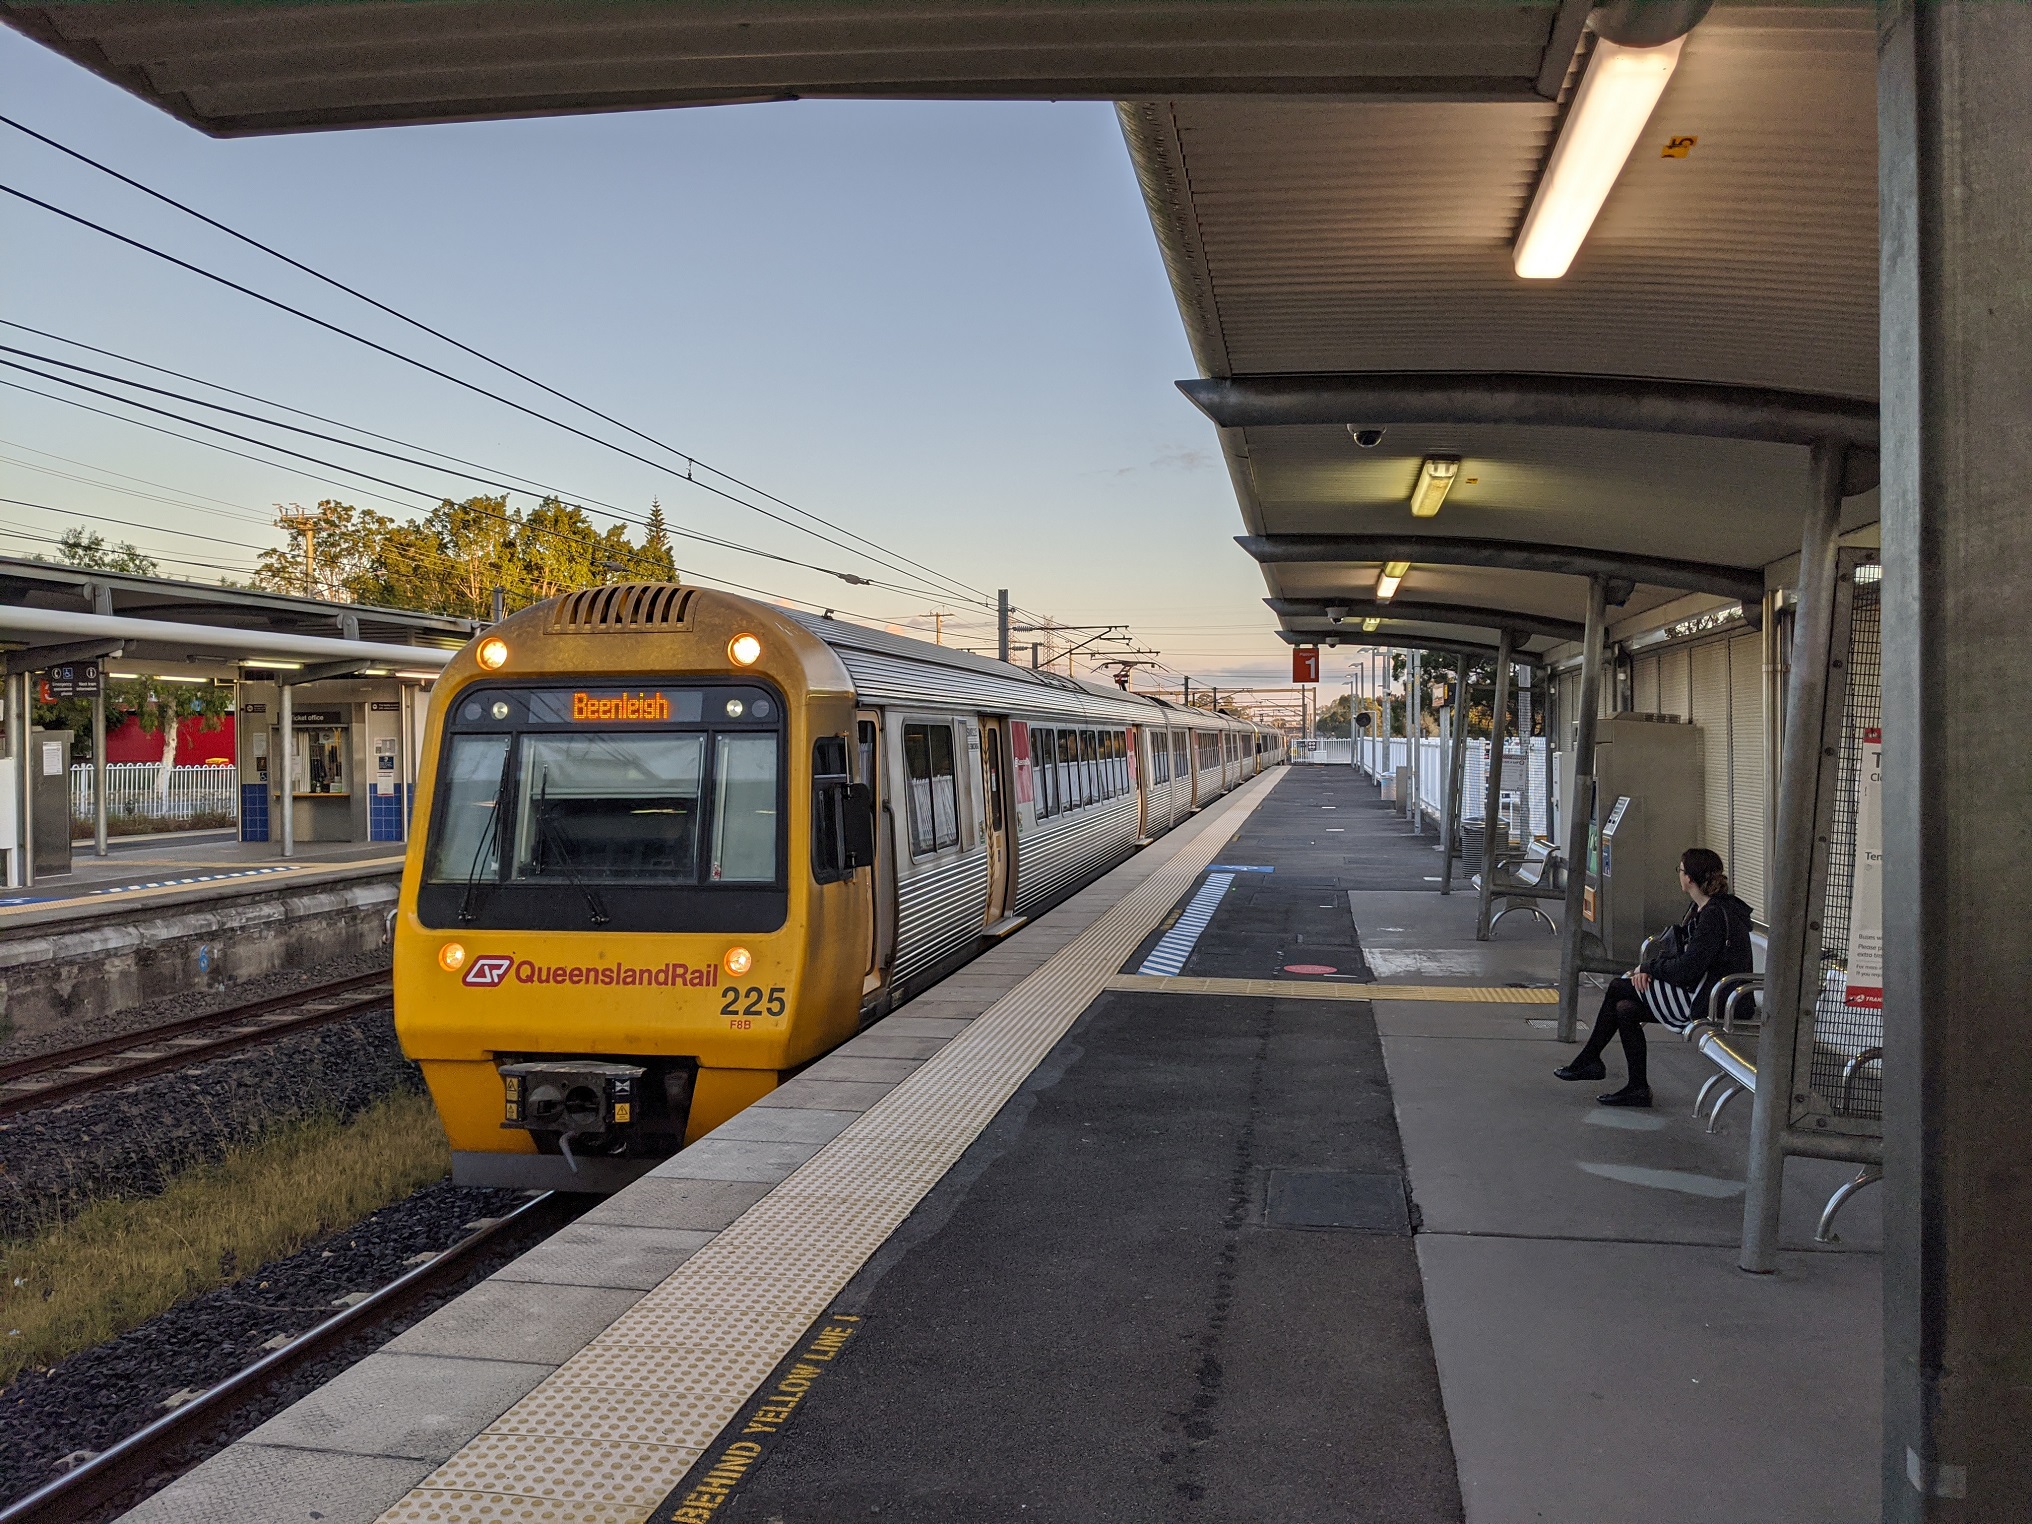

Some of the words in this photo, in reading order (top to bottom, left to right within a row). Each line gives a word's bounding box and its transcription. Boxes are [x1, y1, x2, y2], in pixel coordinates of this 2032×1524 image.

[1305, 657, 1316, 679] 1
[572, 692, 669, 721] Beenleigh
[720, 986, 786, 1017] 225
[729, 1019, 752, 1031] F8B
[671, 1441, 762, 1524] BEHIND
[742, 1363, 822, 1433] YELLOW
[803, 1326, 855, 1361] LINE
